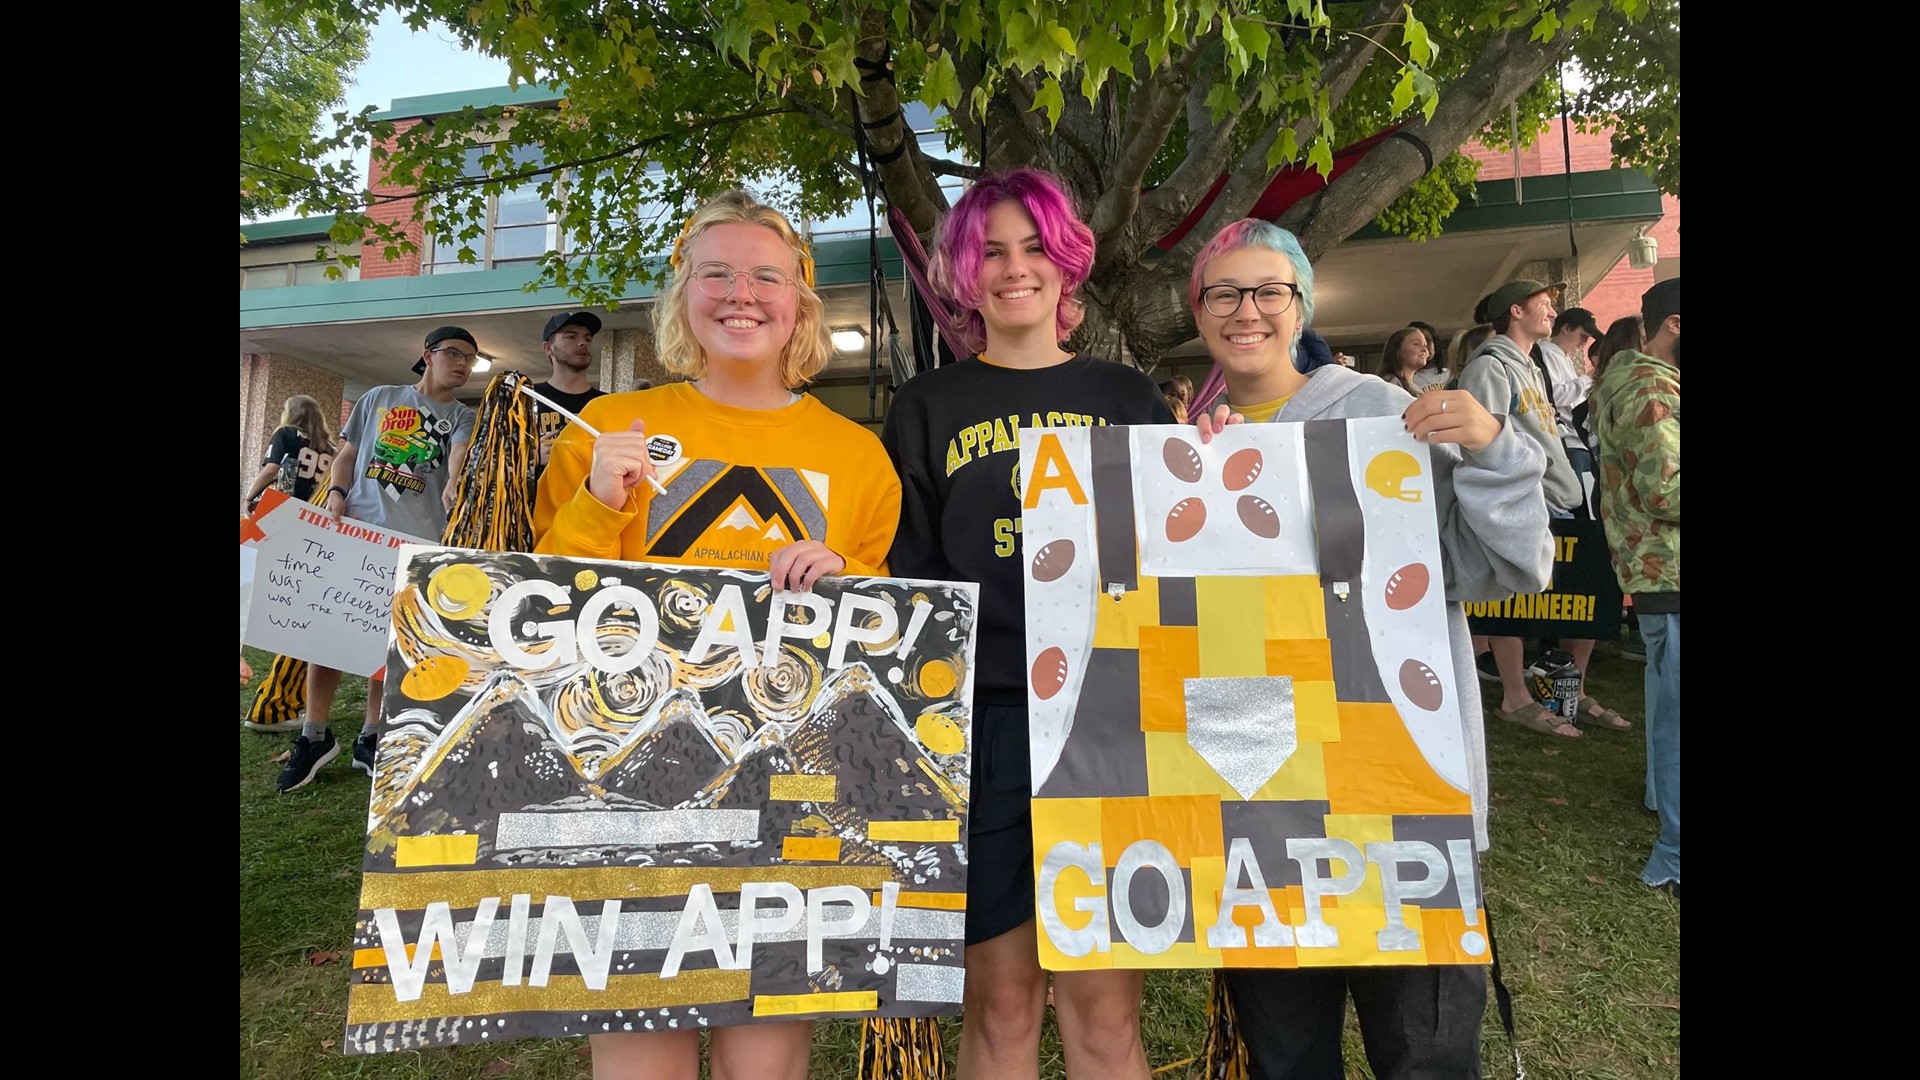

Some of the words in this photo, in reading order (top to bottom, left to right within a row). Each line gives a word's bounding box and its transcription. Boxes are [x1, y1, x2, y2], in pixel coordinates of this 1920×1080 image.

[381, 418, 415, 433] Drop
[385, 407, 417, 420] Sun
[297, 446, 333, 482] 99
[1022, 433, 1089, 510] A
[298, 507, 334, 530] THE
[335, 522, 385, 545] HOME
[303, 538, 335, 562] The
[361, 555, 397, 580] last
[693, 547, 764, 563] APPALACHIAN
[276, 553, 324, 578] time
[353, 578, 395, 607] Troy
[268, 593, 292, 606] was
[307, 603, 333, 614] The
[343, 612, 387, 635] Trojan
[322, 586, 392, 622] releven
[488, 580, 660, 674] GO
[685, 583, 933, 685] APP!
[1038, 839, 1187, 958] GO
[1206, 837, 1488, 957] APP!
[373, 893, 622, 1002] WIN
[659, 880, 900, 979] APP!
